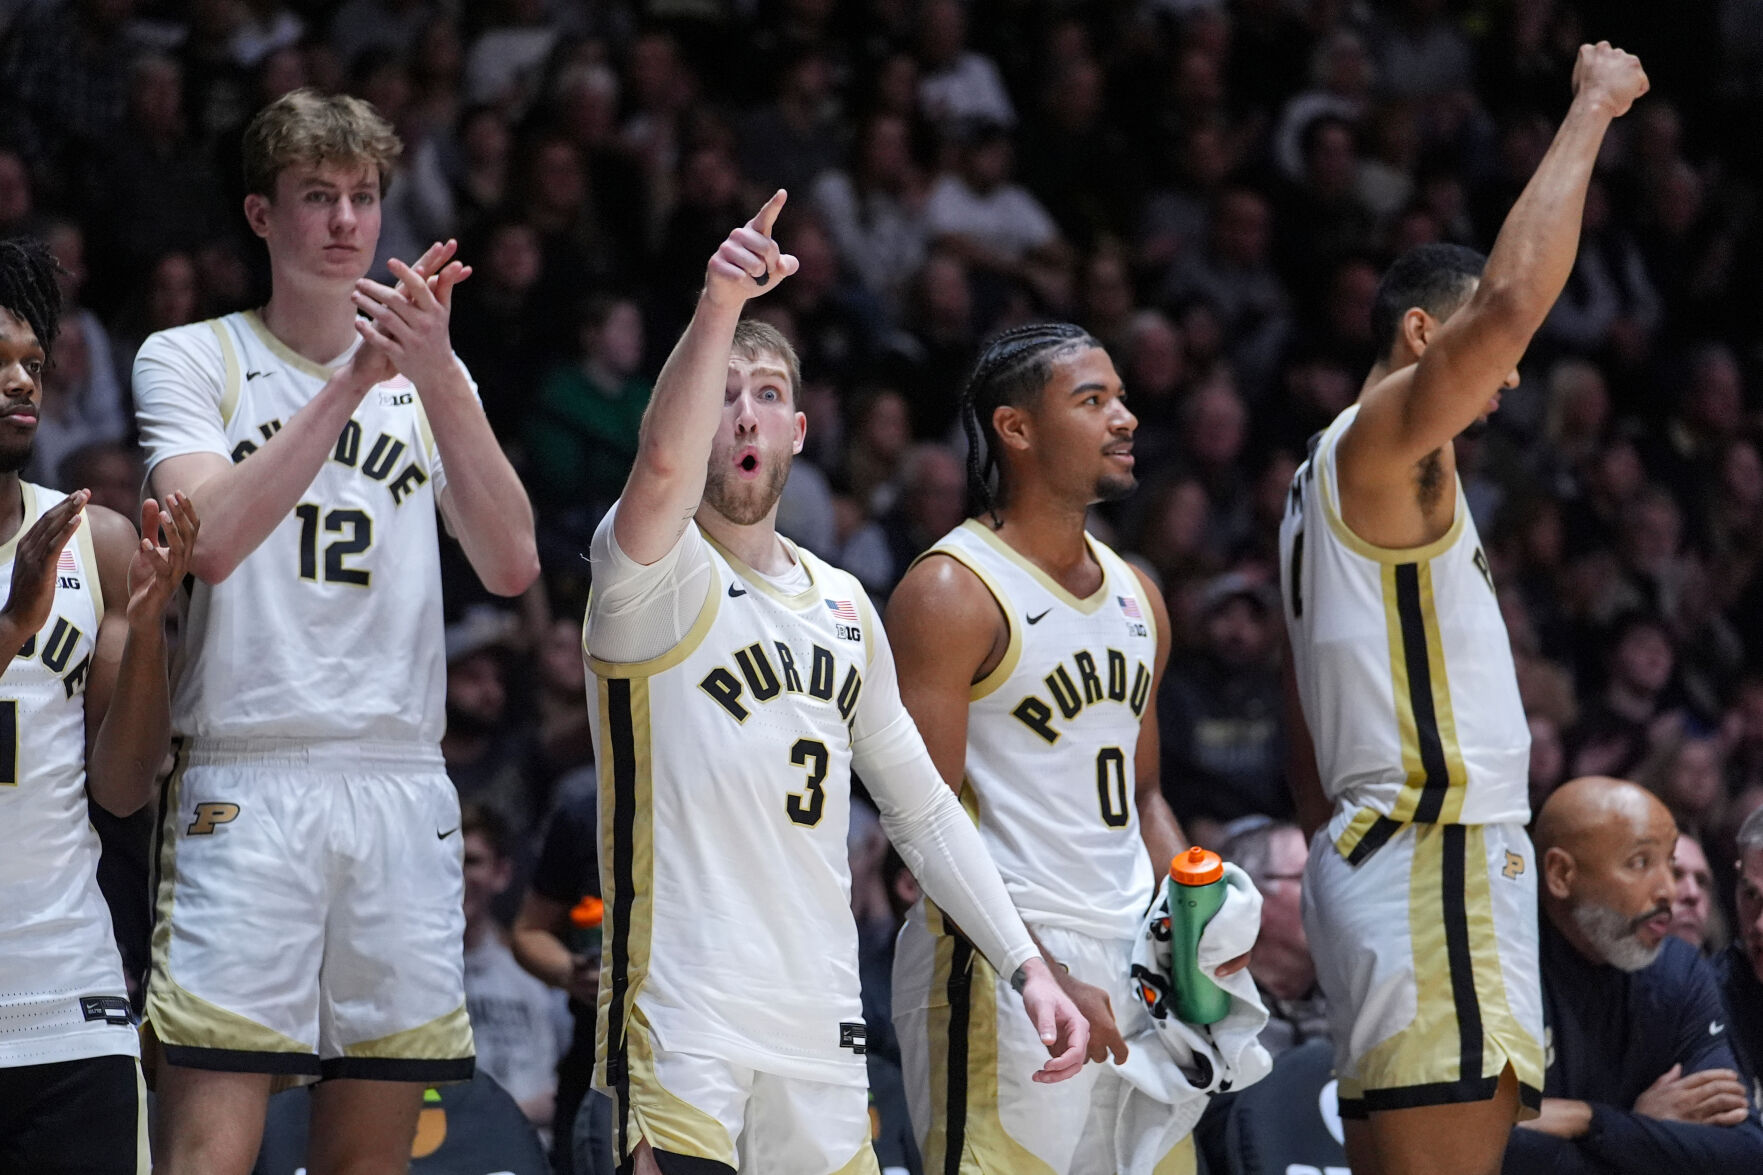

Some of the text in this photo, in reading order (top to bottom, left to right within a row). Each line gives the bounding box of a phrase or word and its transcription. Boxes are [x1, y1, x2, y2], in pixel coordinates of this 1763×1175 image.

[231, 418, 429, 507] DUE
[295, 502, 374, 588] 12
[697, 640, 863, 748] PURDU
[1009, 647, 1152, 746] PURDU
[187, 802, 241, 836] P
[785, 737, 830, 829] 3
[1096, 746, 1130, 831] 0
